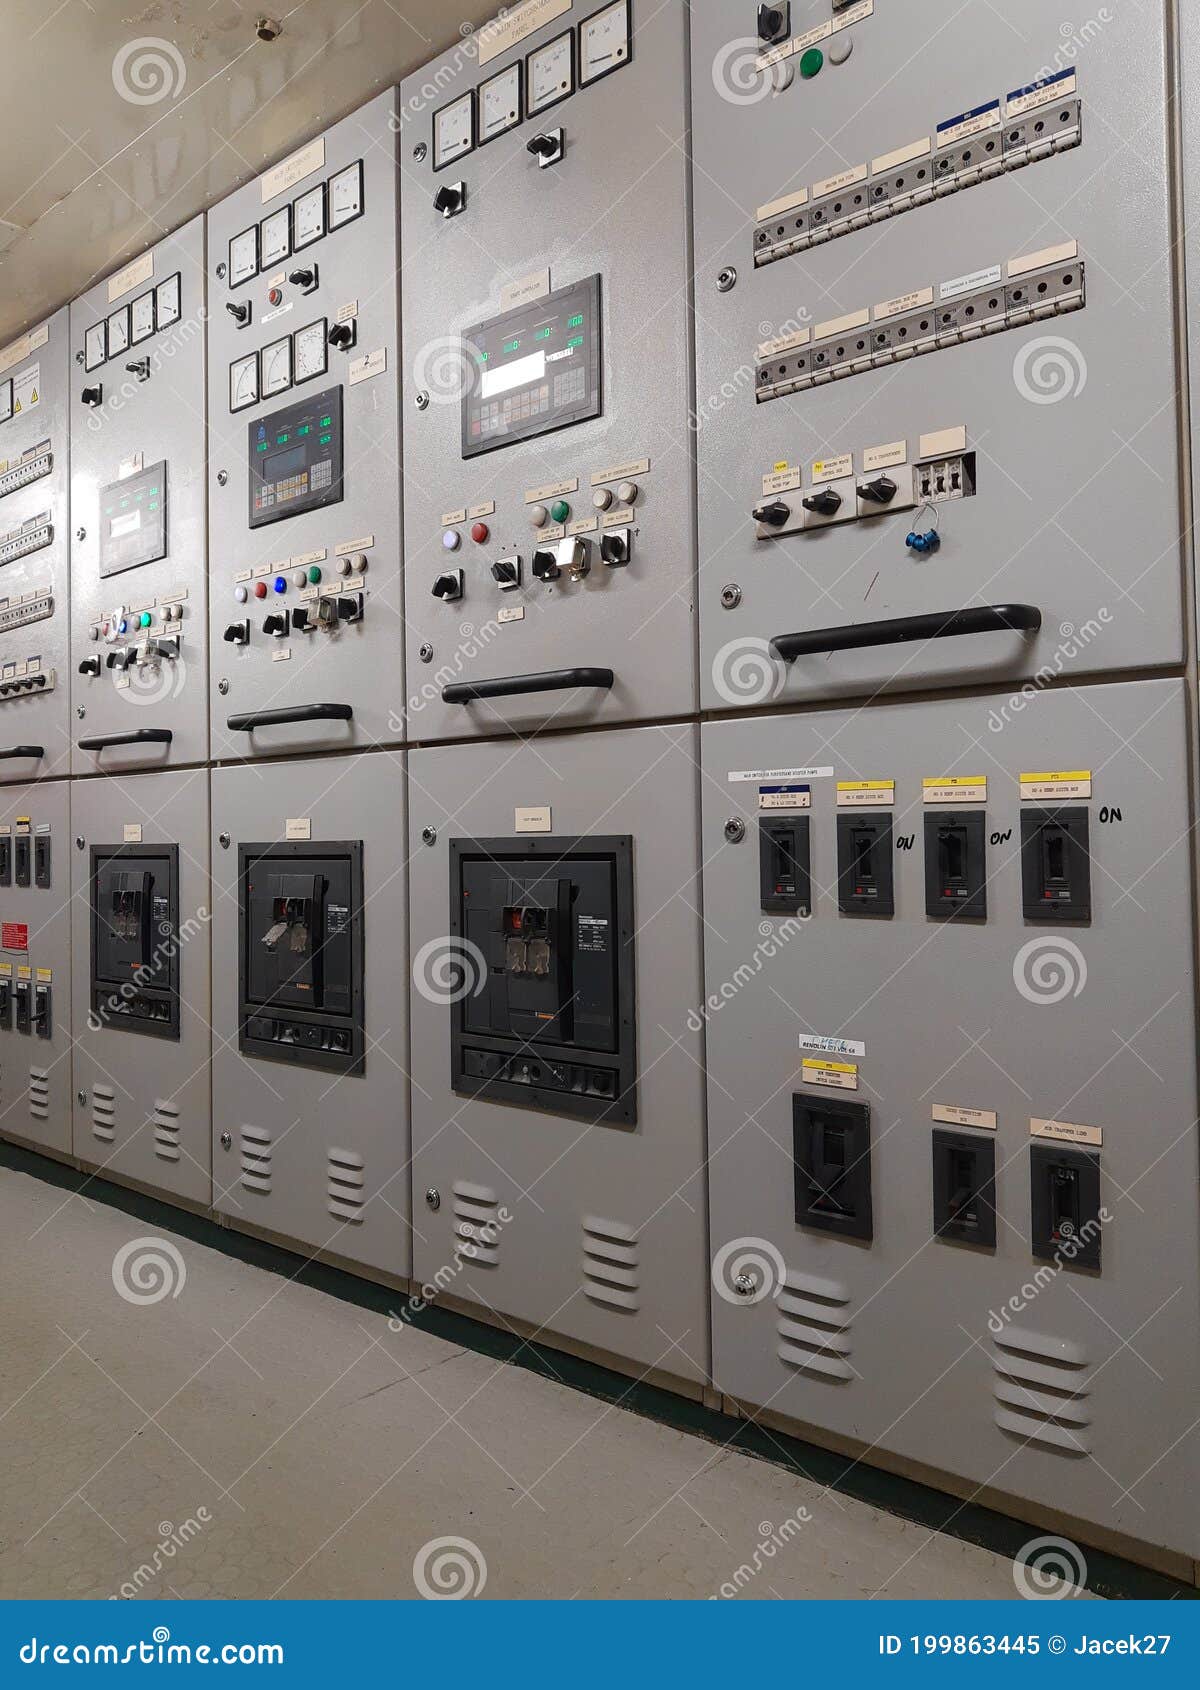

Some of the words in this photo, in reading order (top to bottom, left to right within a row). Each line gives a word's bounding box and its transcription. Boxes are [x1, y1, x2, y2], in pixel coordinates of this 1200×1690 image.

[1099, 806, 1122, 824] ON
[896, 834, 915, 851] ON
[990, 829, 1012, 845] ON
